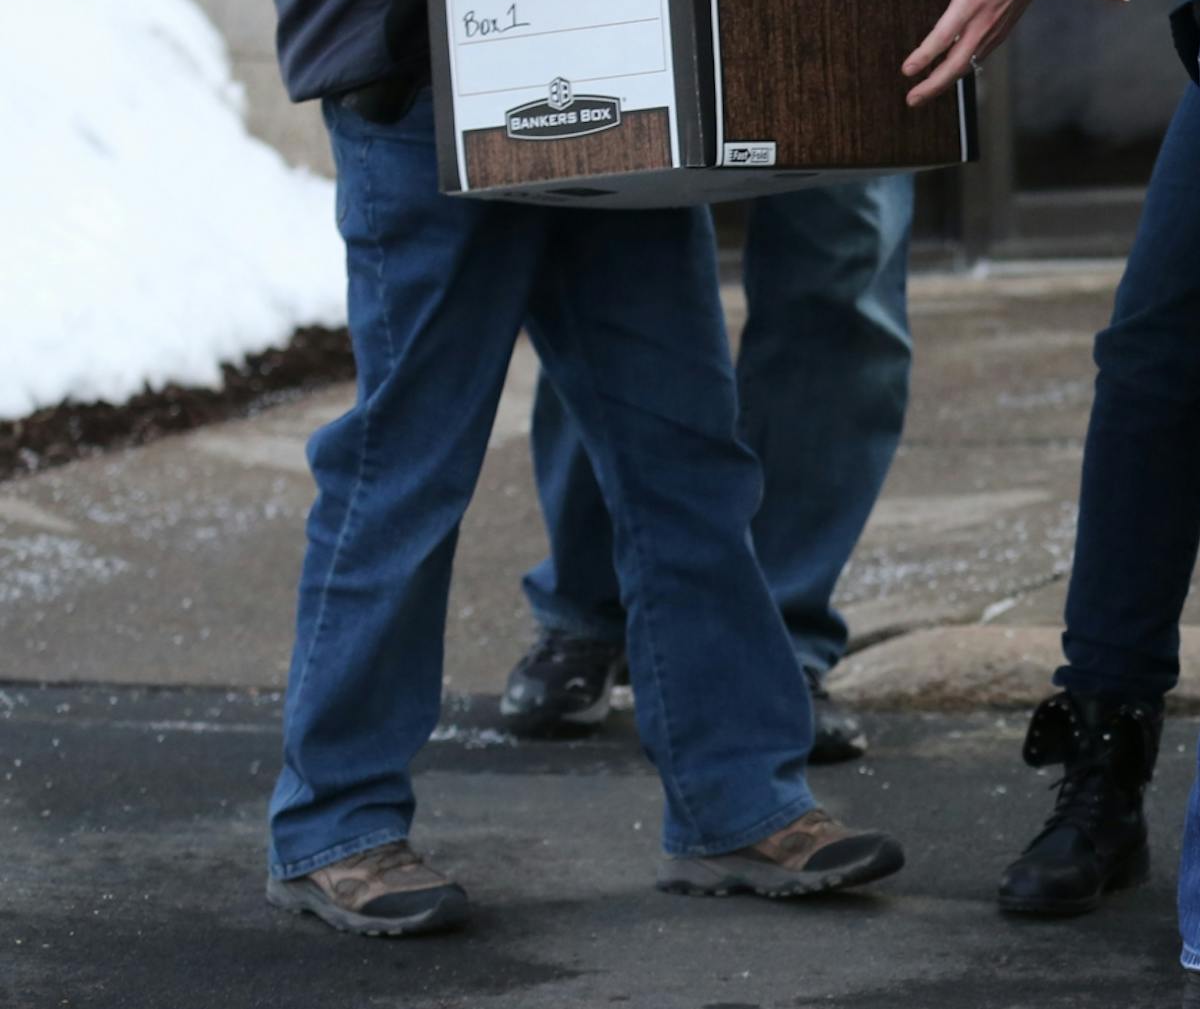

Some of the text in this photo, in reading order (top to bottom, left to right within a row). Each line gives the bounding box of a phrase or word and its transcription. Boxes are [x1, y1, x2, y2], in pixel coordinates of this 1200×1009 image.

[462, 10, 501, 38] Box
[510, 107, 612, 131] BANKERS BOX
